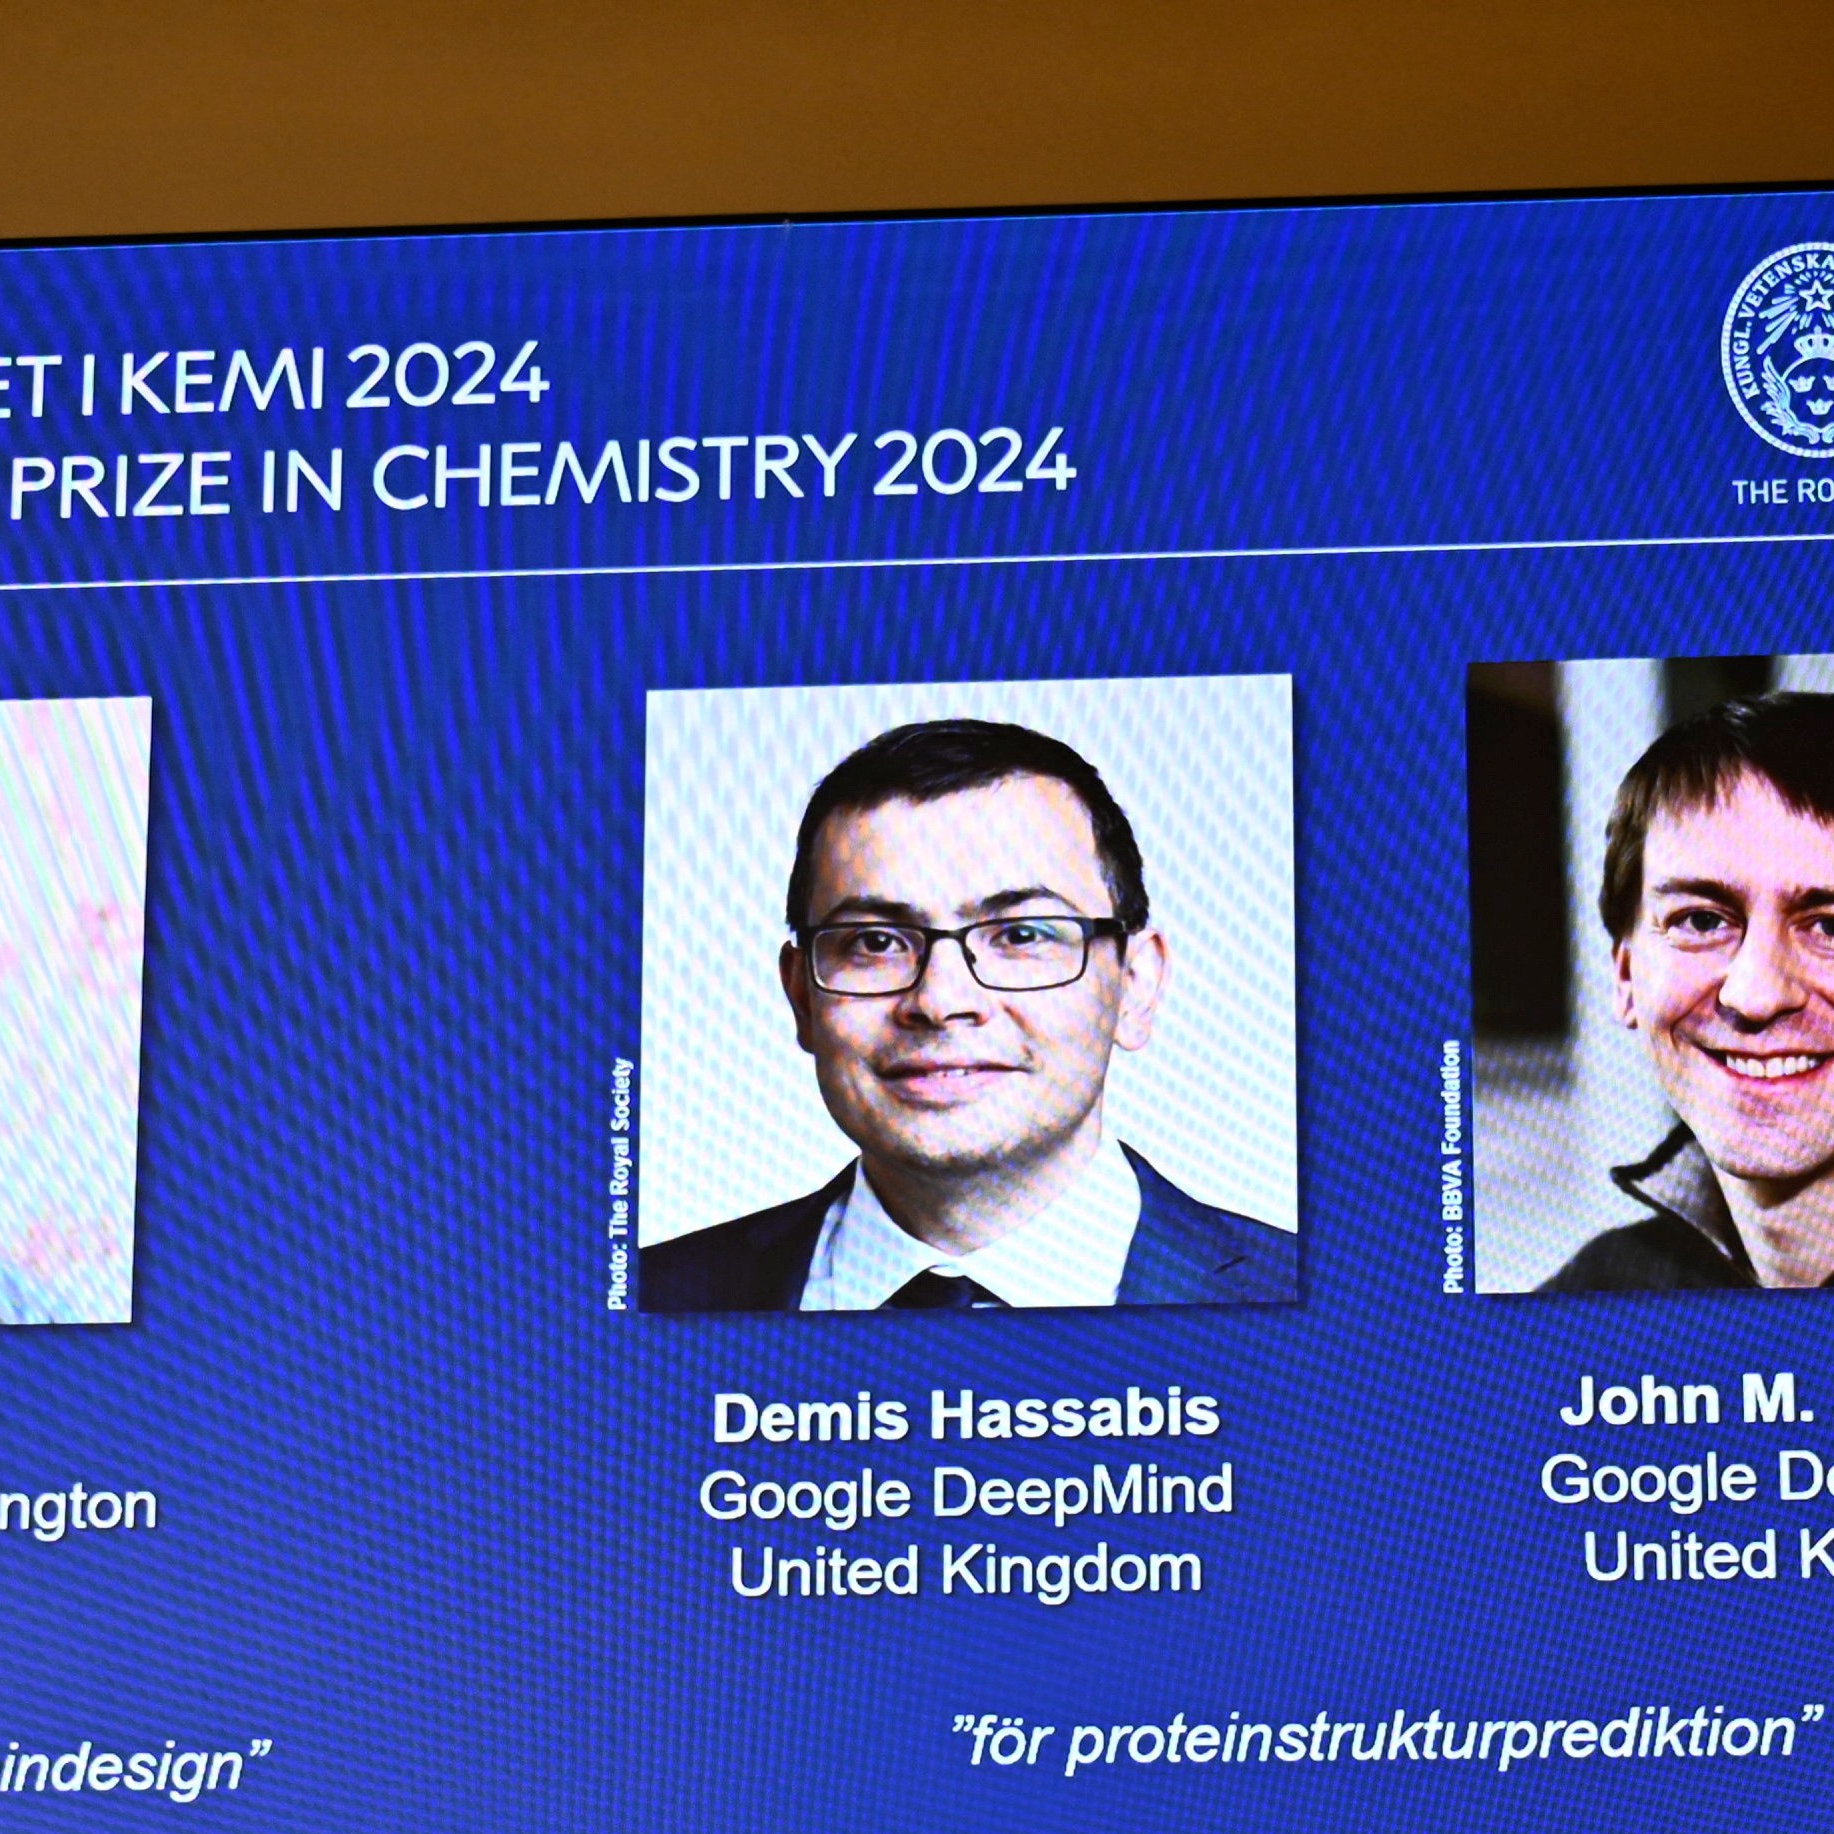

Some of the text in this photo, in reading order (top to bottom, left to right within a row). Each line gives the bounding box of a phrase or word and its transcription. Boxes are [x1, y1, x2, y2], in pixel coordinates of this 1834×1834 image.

[82, 355, 94, 415] I
[122, 348, 323, 414] KEMI
[347, 341, 549, 407] 2024
[1733, 322, 1761, 399] KUNGL.
[11, 452, 231, 519] PRIZE
[263, 449, 342, 512] IN
[374, 434, 857, 509] CHEMISTRY
[874, 428, 1076, 494] 2024
[1733, 480, 1788, 504] THE
[607, 1057, 635, 1311] Photo: The Royal Society
[1440, 1040, 1465, 1295] Photo: BBVA Foundation
[715, 1387, 1219, 1442] Demis Hassabis
[1561, 1375, 1719, 1425] John
[1743, 1373, 1813, 1422] M.
[701, 1463, 1232, 1530] Google DeepMind
[1542, 1452, 1756, 1514] Google
[733, 1542, 1200, 1605] United Kingdom
[1586, 1529, 1776, 1581] United
[953, 1705, 1824, 1776] ”för proteinstrukturprediktion”
